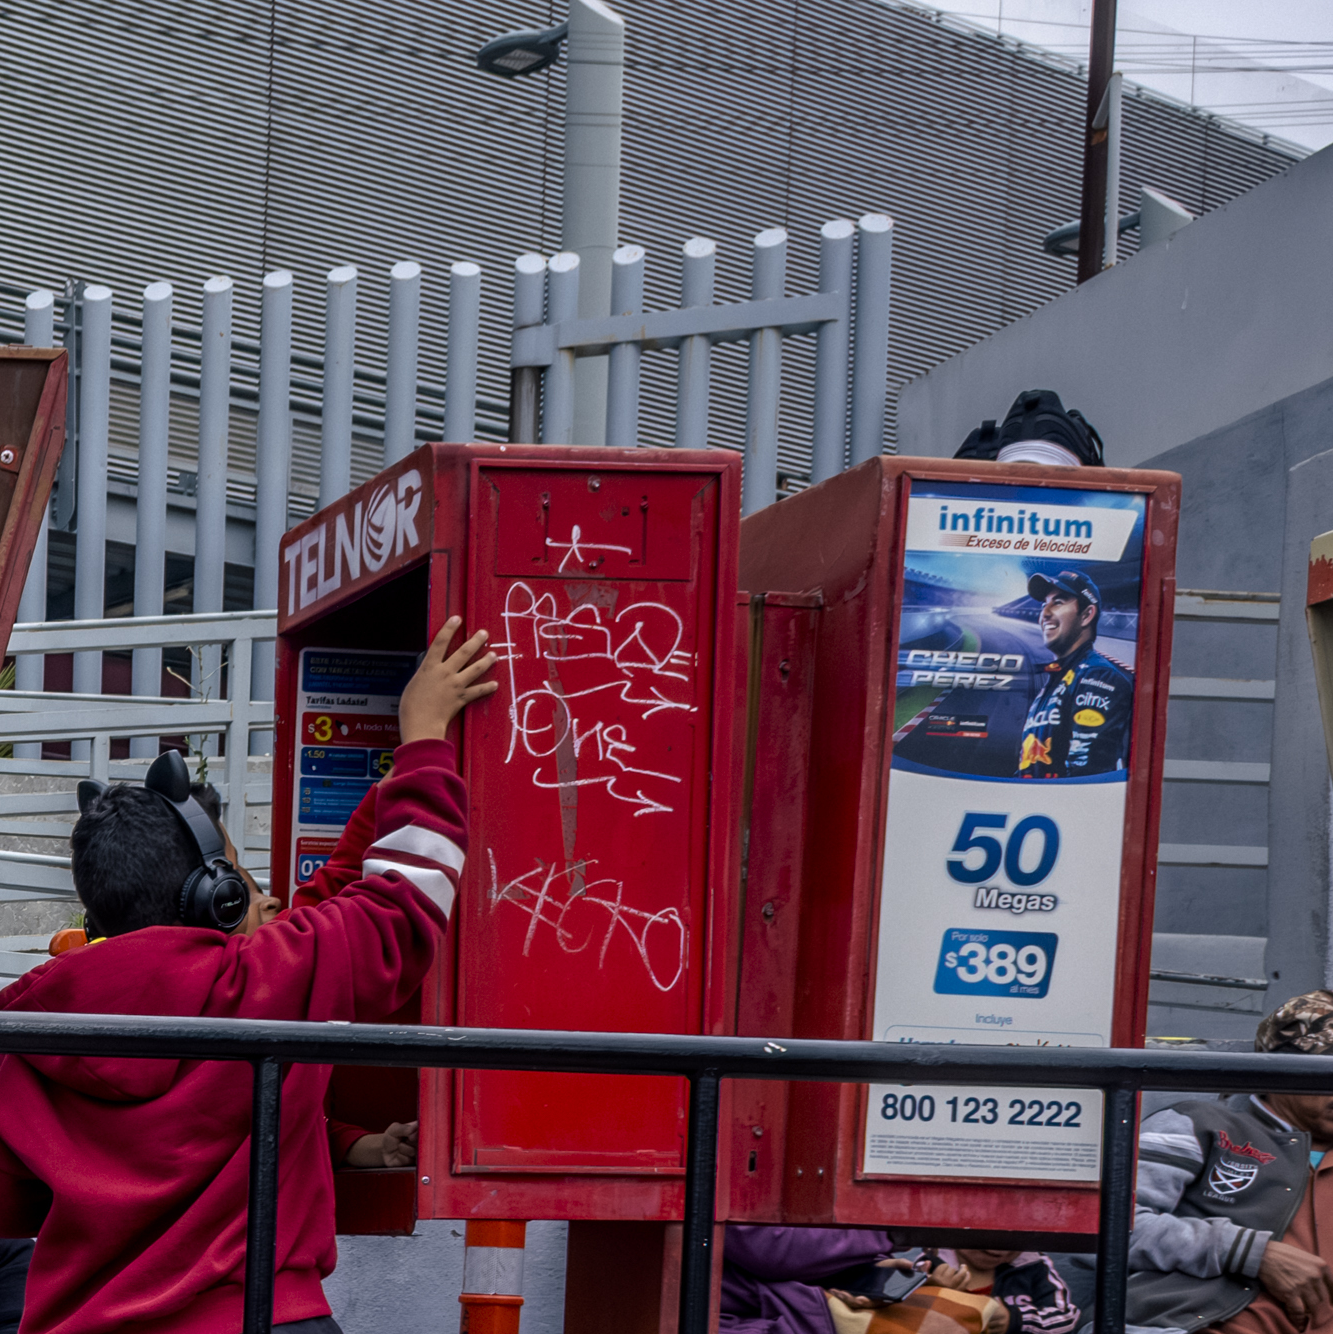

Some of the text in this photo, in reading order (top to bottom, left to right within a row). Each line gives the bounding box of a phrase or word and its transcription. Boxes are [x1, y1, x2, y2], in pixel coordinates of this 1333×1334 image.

[938, 505, 1092, 538] infinitum
[285, 469, 422, 616] TELNOR
[965, 535, 1091, 554] Exceso de Velocidad
[906, 650, 1024, 672] CHECO
[306, 696, 368, 706] Tarifas Ladatel
[1075, 692, 1110, 711] citrix
[307, 715, 333, 742] $3
[946, 811, 1060, 887] 50
[974, 888, 1058, 913] Megas
[951, 931, 989, 942] Por solo
[944, 942, 1047, 986] $389
[1019, 986, 1039, 994] mes
[975, 1013, 1012, 1027] Incluye
[881, 1093, 1082, 1127] 800 123 2222
